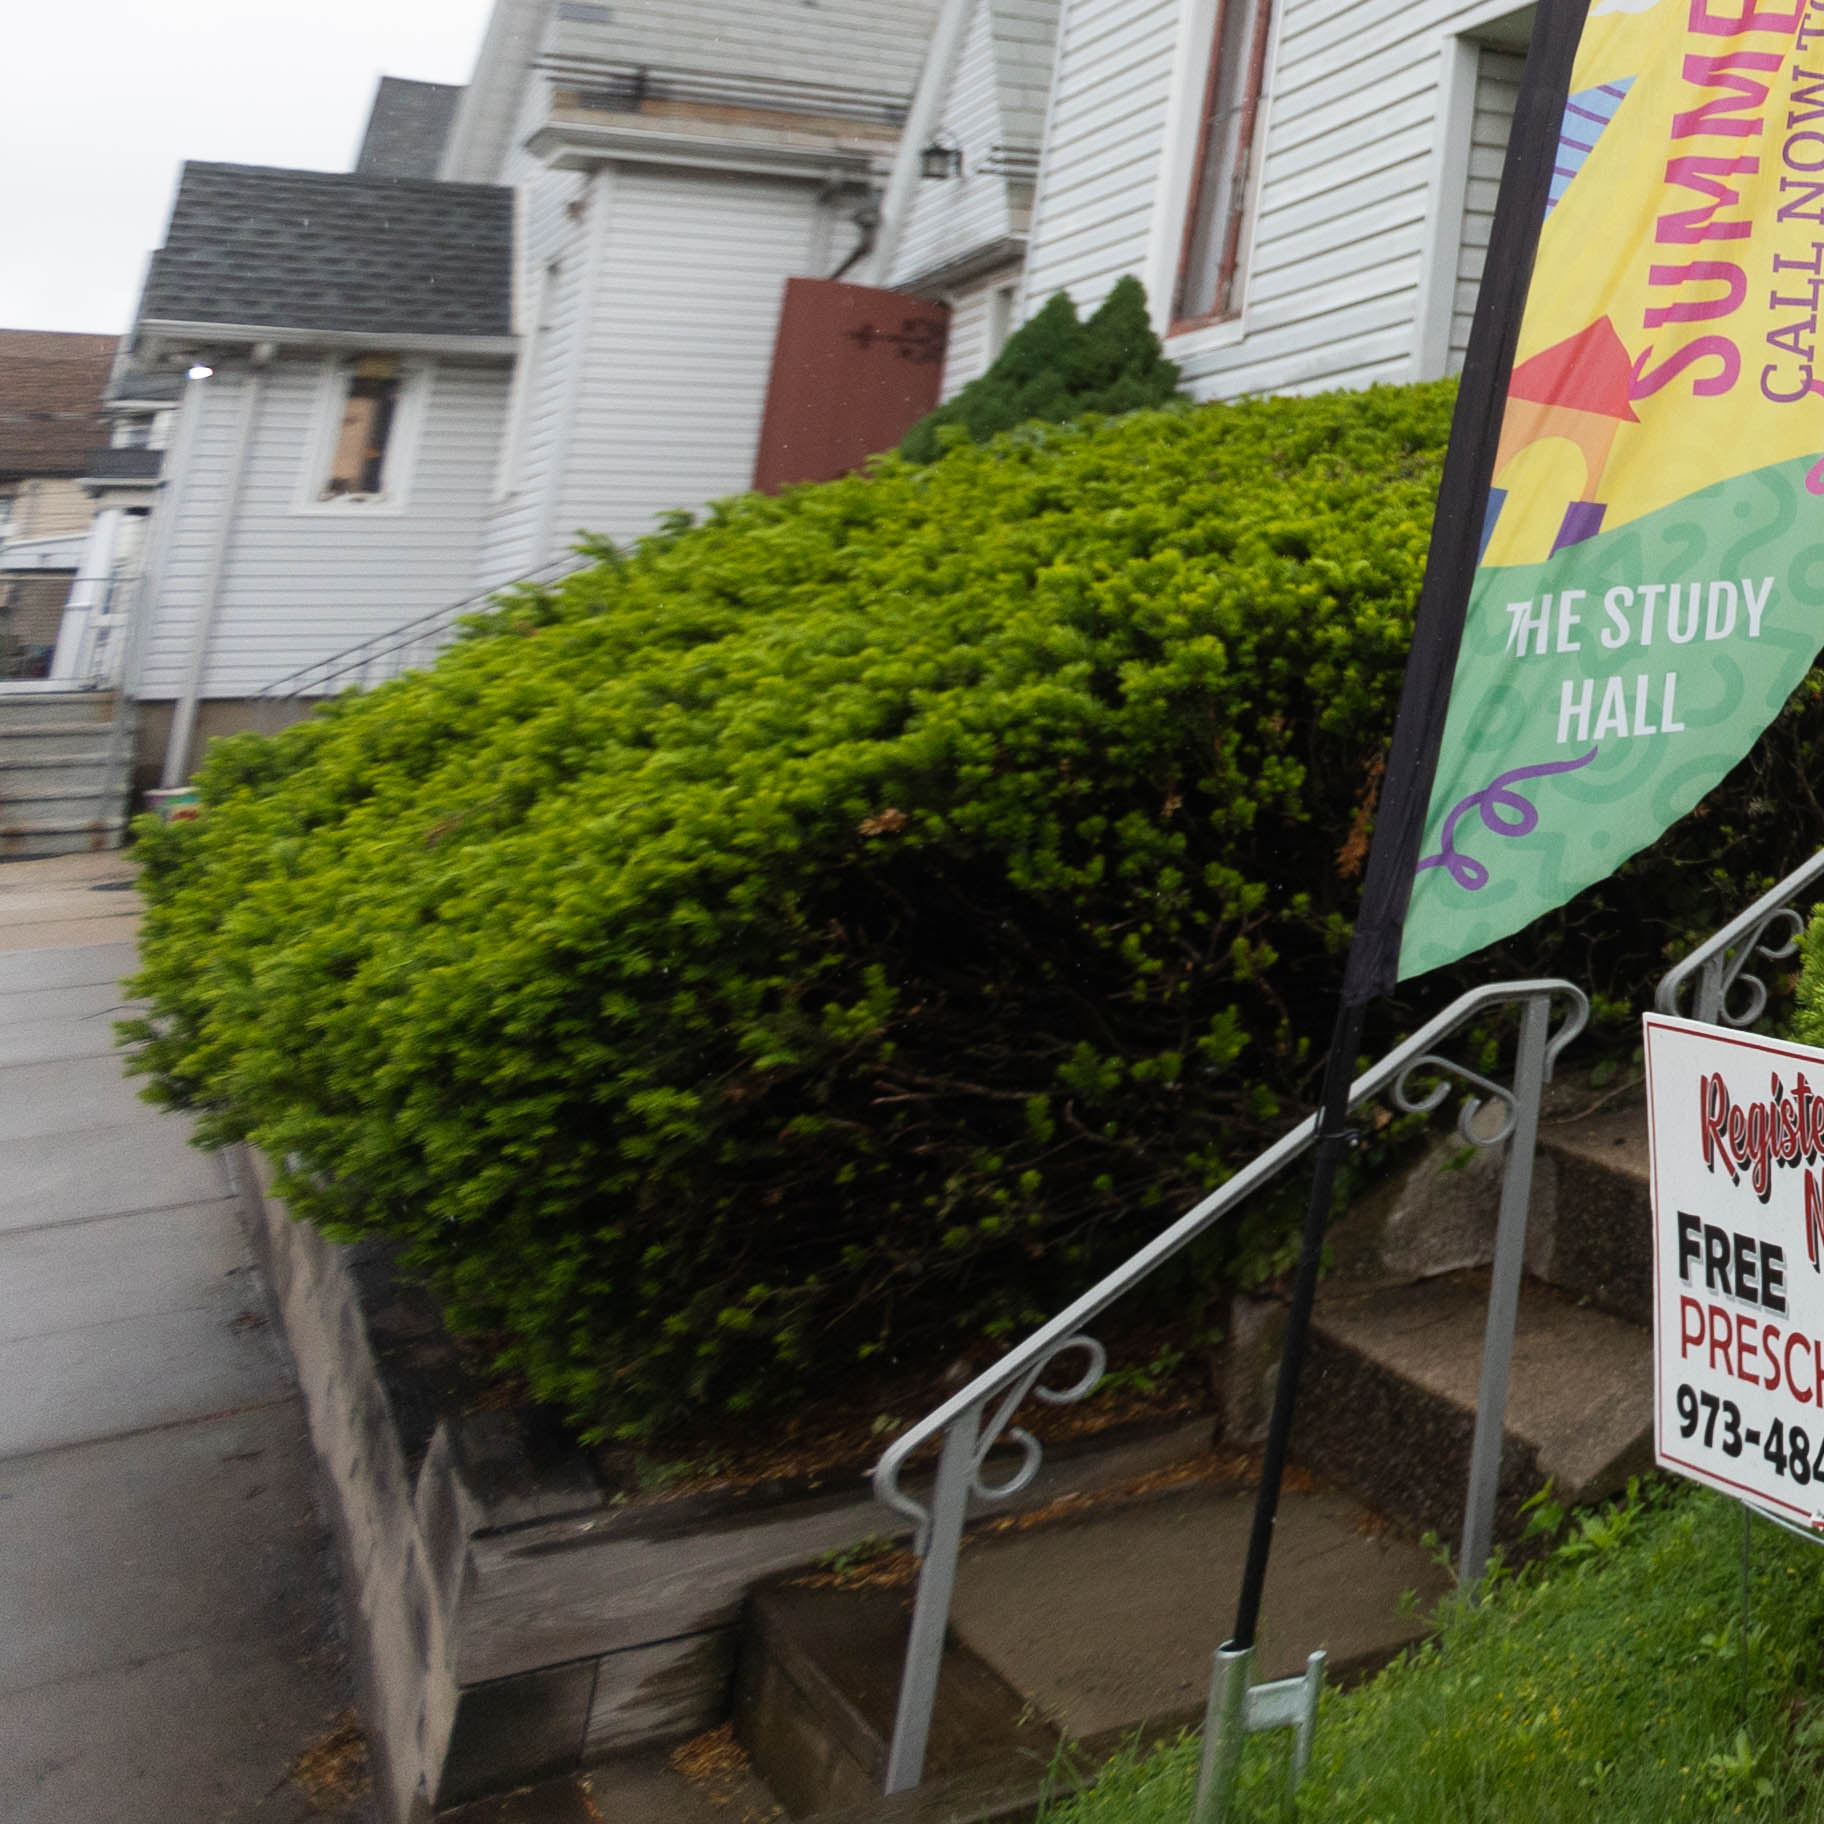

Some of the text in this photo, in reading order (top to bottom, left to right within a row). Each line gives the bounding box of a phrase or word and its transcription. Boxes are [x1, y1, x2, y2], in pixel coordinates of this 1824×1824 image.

[1505, 576, 1776, 657] THE STUDY
[1556, 672, 1686, 744] HALL
[1676, 1210, 1789, 1319] FREE
